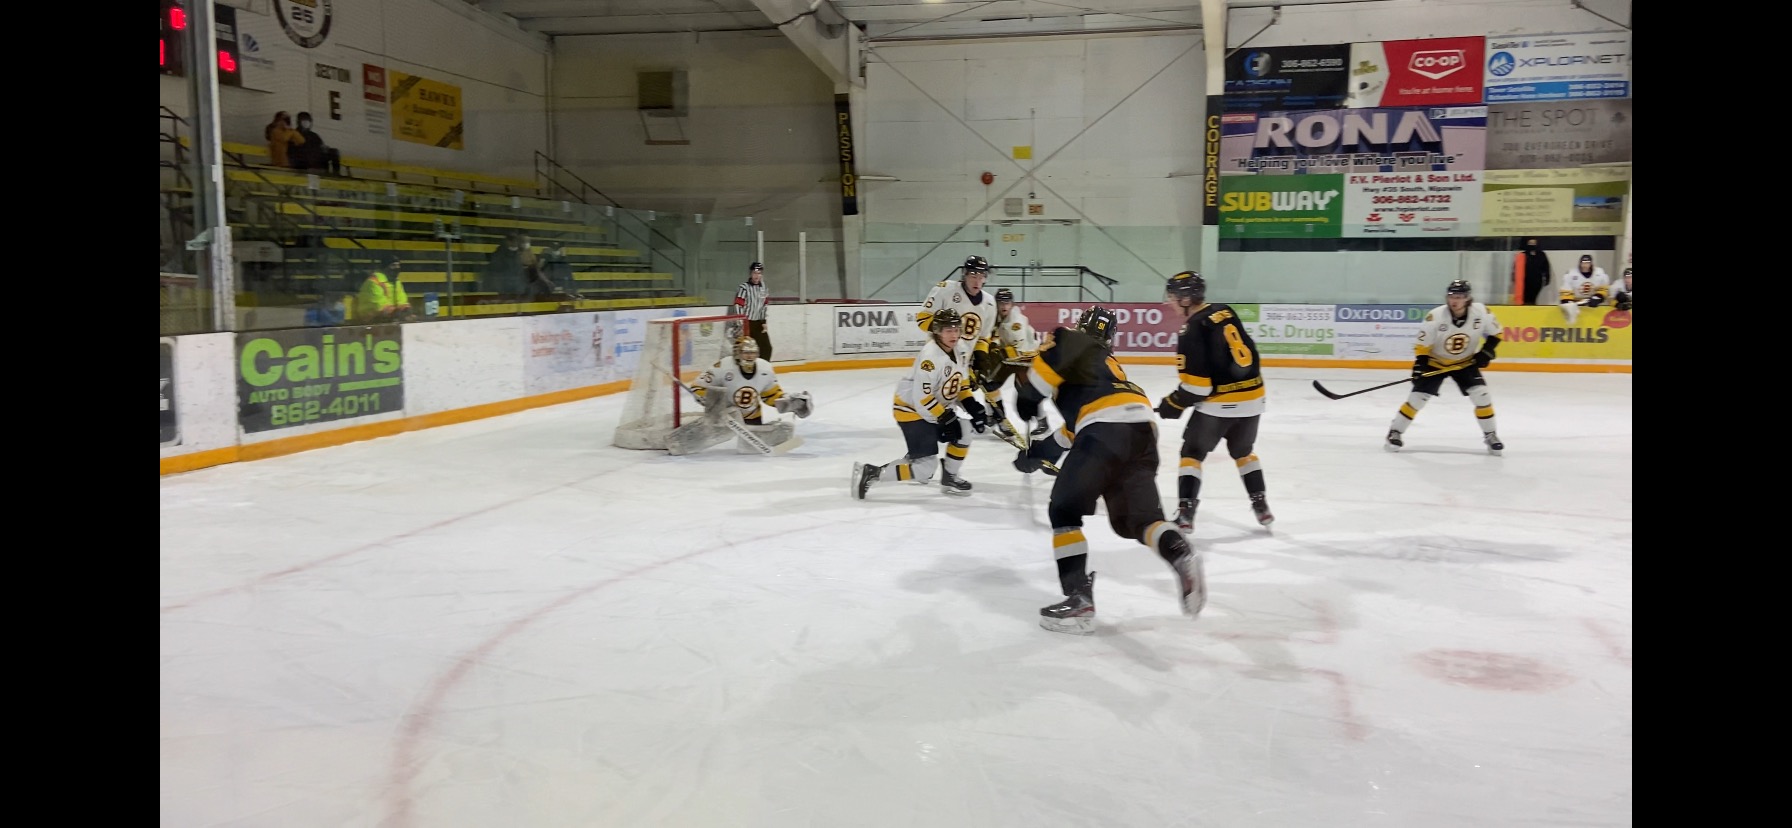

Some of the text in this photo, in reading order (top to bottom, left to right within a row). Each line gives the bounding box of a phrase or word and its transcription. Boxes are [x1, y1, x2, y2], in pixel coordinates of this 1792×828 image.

[1414, 55, 1460, 68] CO-OP
[1519, 53, 1626, 68] XPLORNET
[329, 90, 341, 121] E
[1490, 110, 1532, 128] THE
[1541, 108, 1599, 127] SPOT
[1254, 110, 1441, 149] RONA
[838, 112, 856, 197] PASSION
[1205, 115, 1220, 207] COURAGE
[1294, 158, 1315, 170] you
[1319, 156, 1349, 167] love
[1353, 155, 1396, 166] where
[1401, 156, 1425, 168] you
[1414, 174, 1423, 183] &
[1427, 174, 1450, 183] Son
[1453, 173, 1477, 182] Ltd.
[1219, 189, 1340, 213] SUBWAY
[1003, 233, 1025, 243] EXIT
[837, 310, 899, 328] RONA
[1057, 308, 1163, 325] PRD TO
[1338, 307, 1406, 321] OXFORD
[1127, 331, 1179, 348] LOCA
[1258, 323, 1281, 338] St.
[1284, 323, 1334, 342] Drugs
[1223, 323, 1253, 368] 8
[240, 334, 401, 387] Cain's
[249, 384, 332, 405] AUTO BODY
[922, 382, 932, 395] 5
